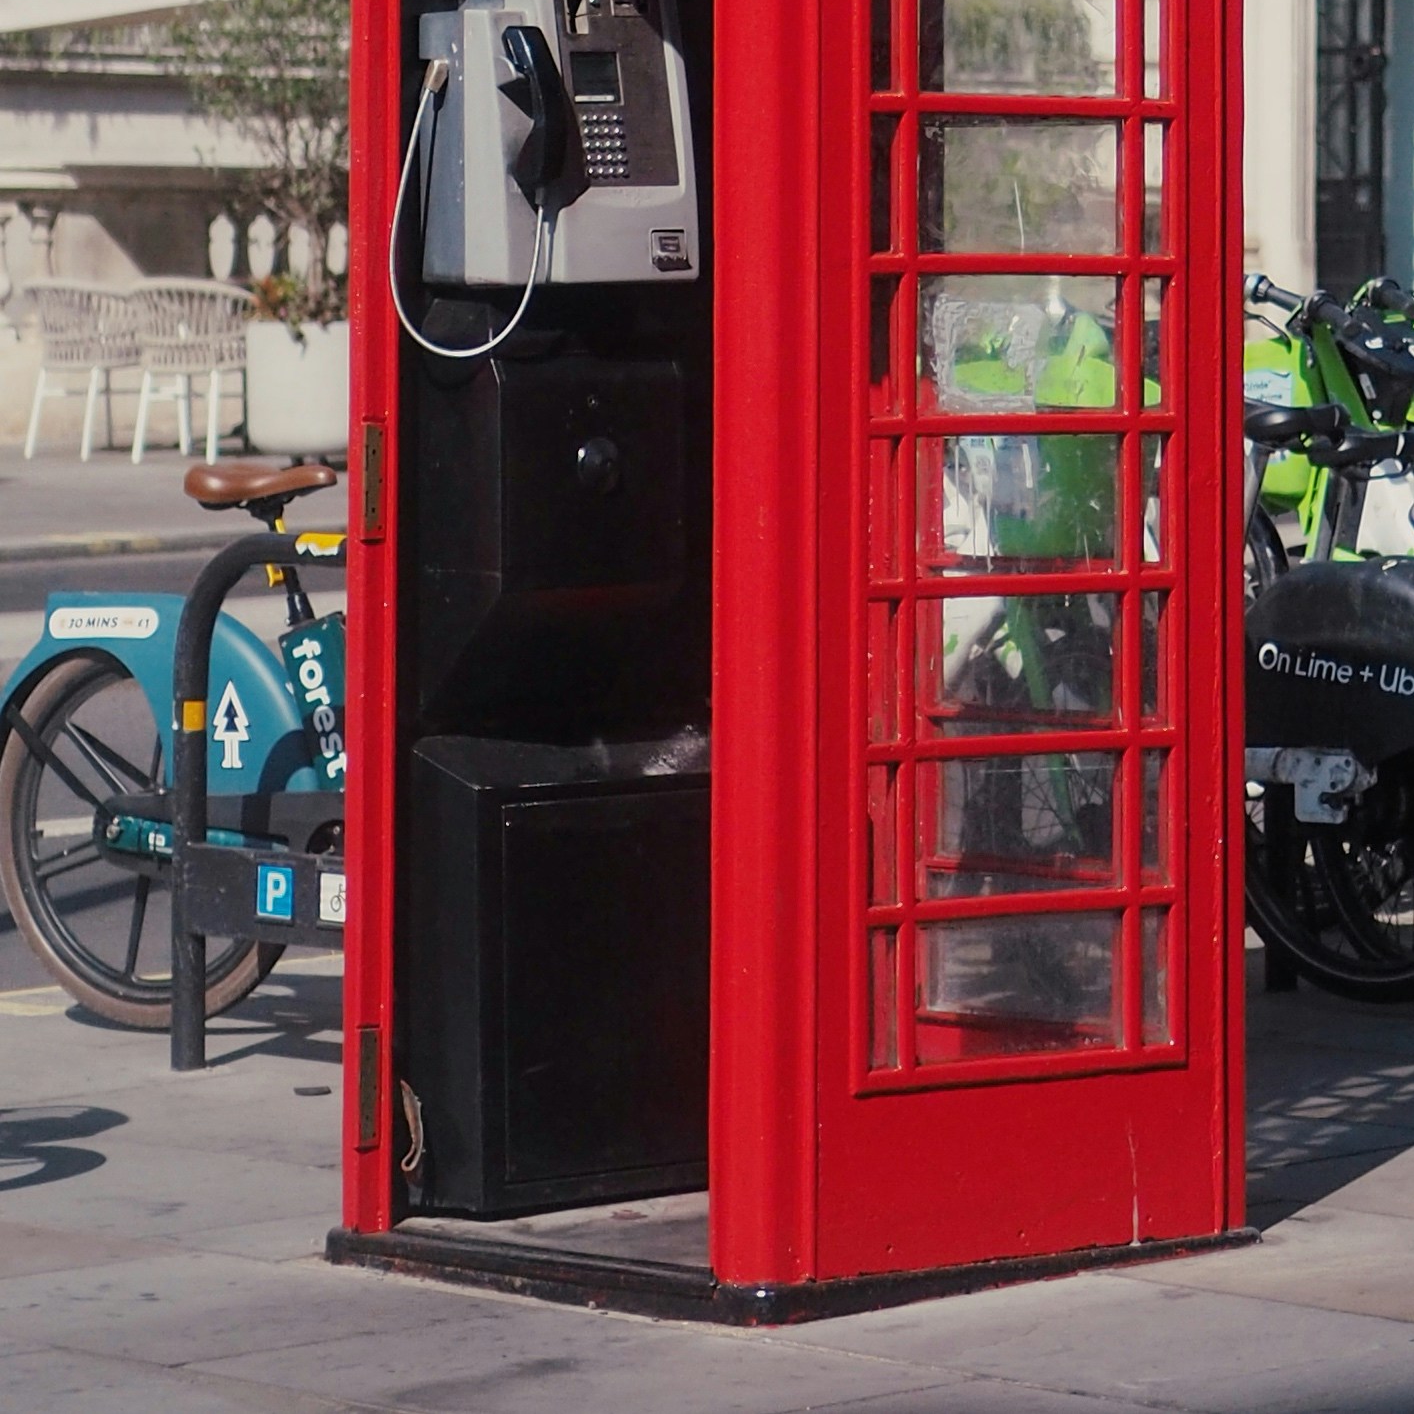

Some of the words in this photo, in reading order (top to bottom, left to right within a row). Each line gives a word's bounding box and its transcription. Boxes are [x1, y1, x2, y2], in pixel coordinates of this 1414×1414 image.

[85, 616, 119, 628] MINS
[1258, 642, 1291, 673] On
[1294, 651, 1353, 684] Lime
[1359, 665, 1374, 683] +
[292, 638, 347, 779] forest
[266, 872, 287, 913] P
